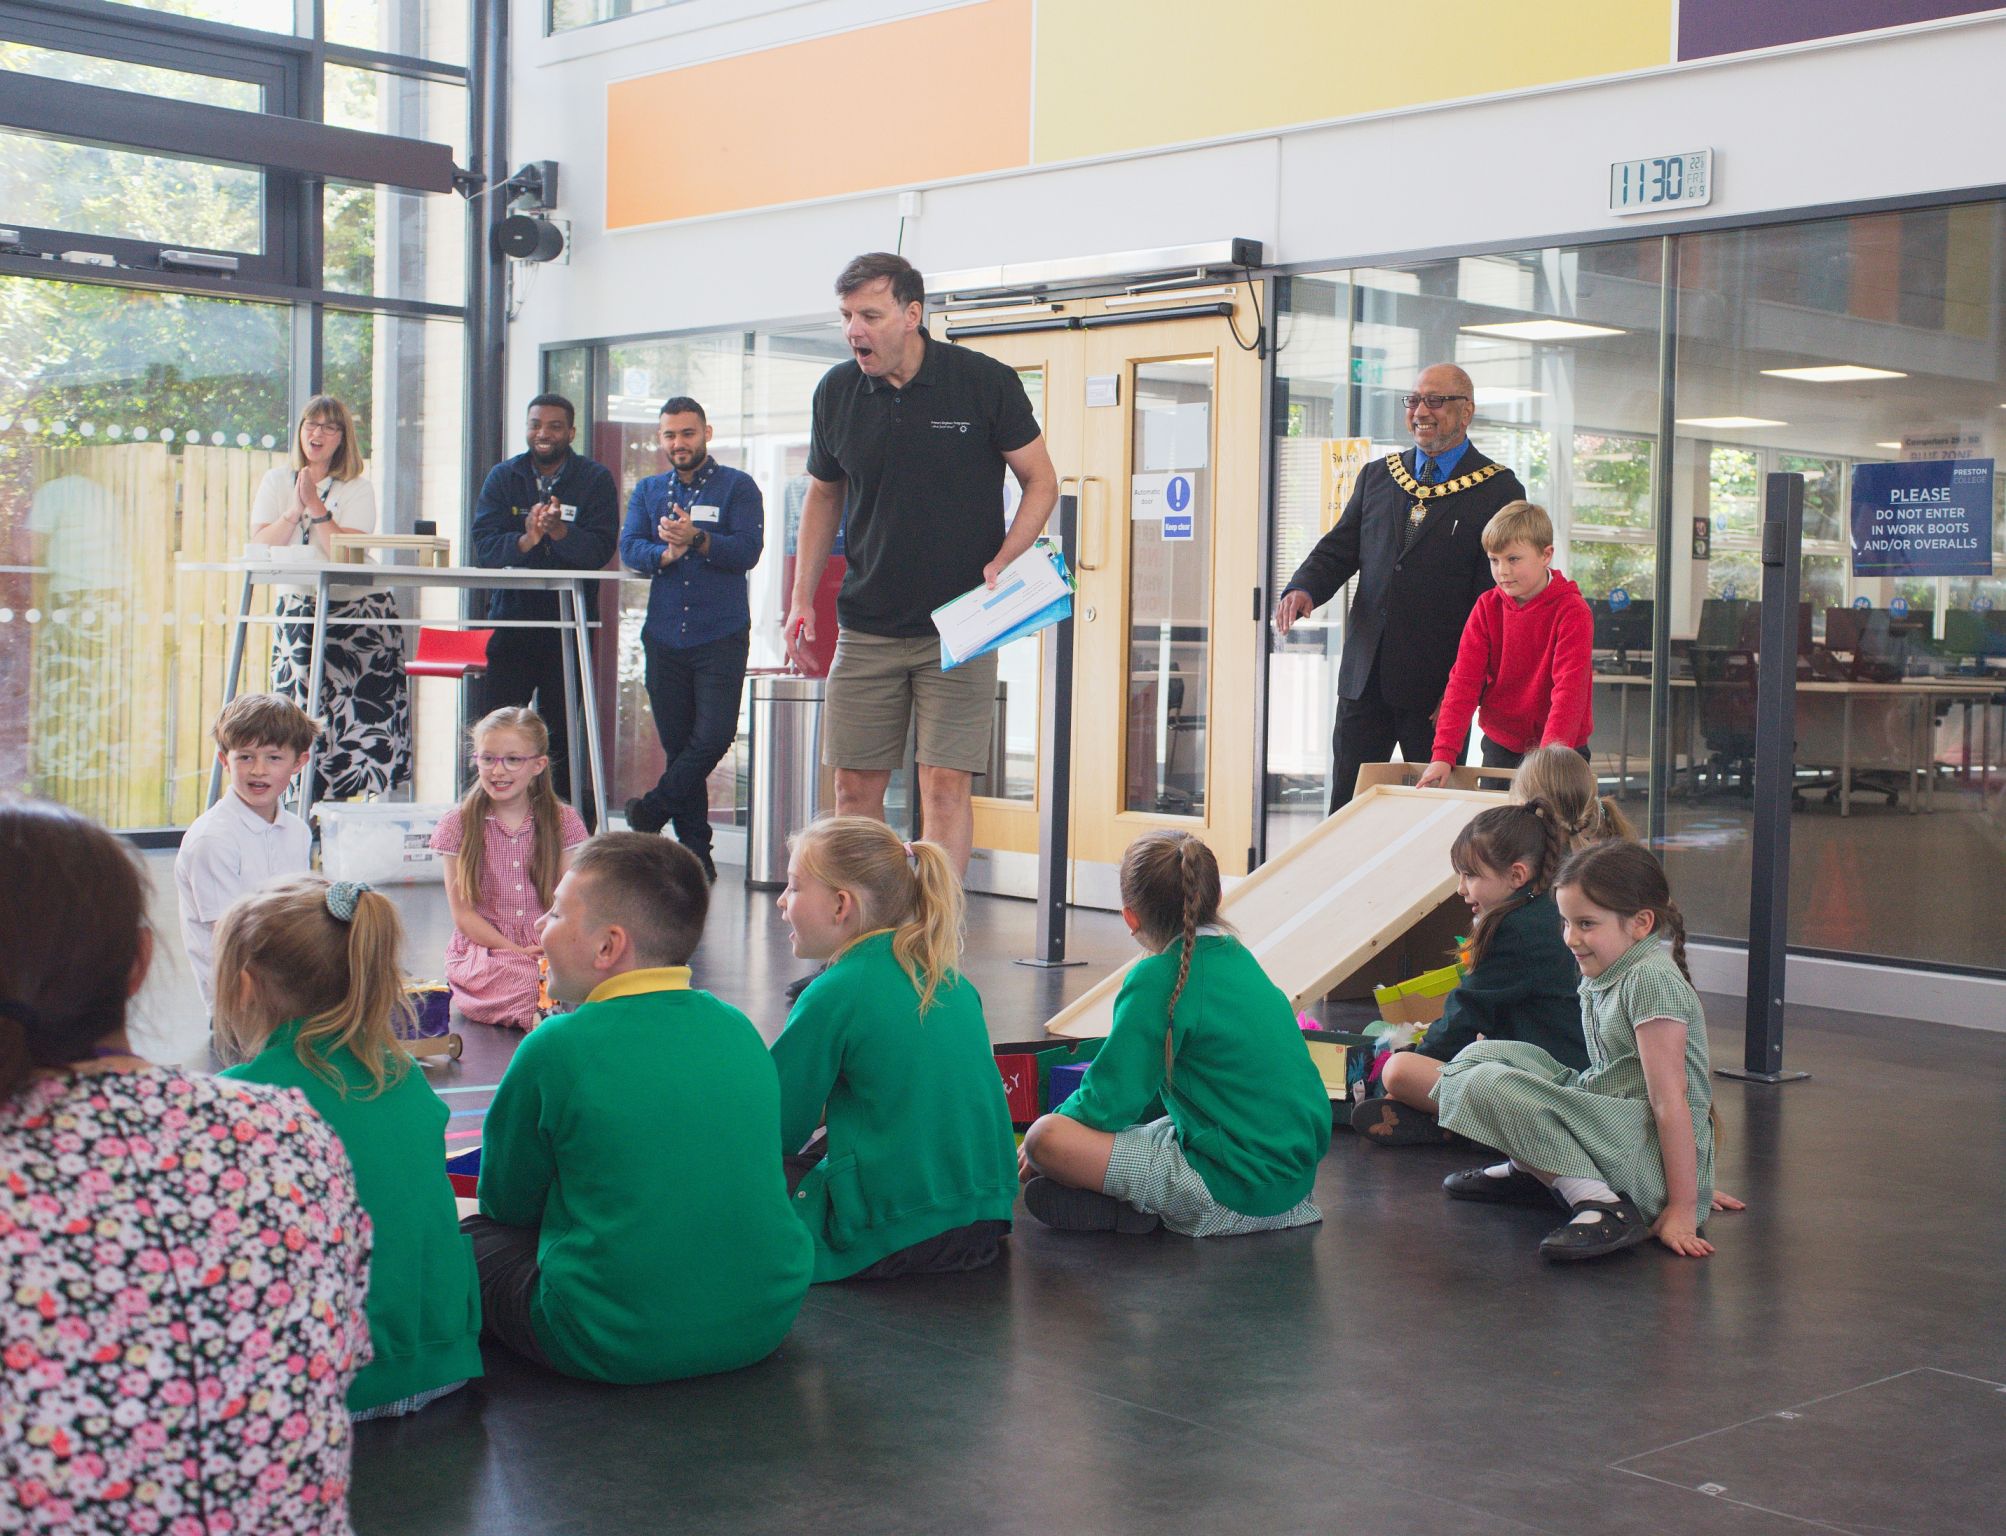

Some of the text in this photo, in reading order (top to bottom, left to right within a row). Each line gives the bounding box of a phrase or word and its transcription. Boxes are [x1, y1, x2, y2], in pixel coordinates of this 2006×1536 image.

[1953, 476, 1987, 484] COLLEGE
[1890, 487, 1951, 503] PLEASE
[1876, 507, 1965, 520] DO NOT ENTER
[1871, 523, 1969, 535] IN WORK BOOTS
[1864, 538, 1978, 552] AND/OR OVERALLS
